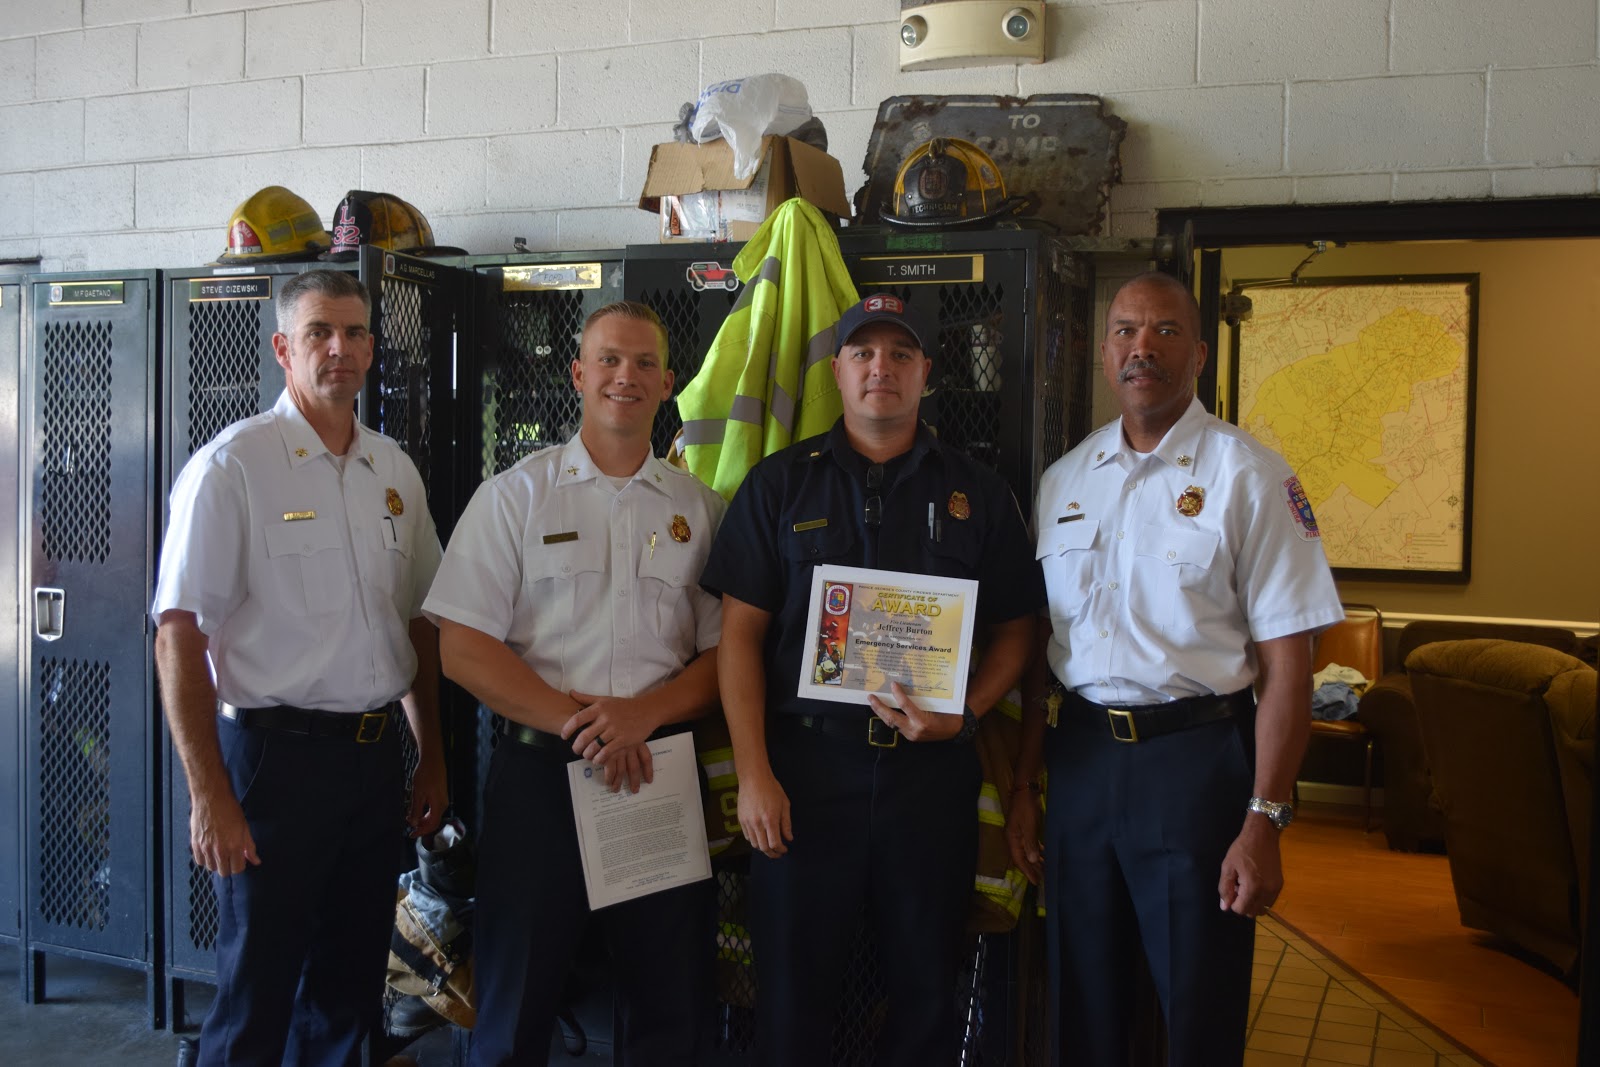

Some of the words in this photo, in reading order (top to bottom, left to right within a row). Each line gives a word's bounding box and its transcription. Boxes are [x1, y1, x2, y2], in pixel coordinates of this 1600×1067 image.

[1008, 114, 1040, 129] TO
[340, 205, 355, 224] L
[333, 225, 360, 245] 32
[887, 265, 897, 276] T.
[900, 264, 936, 276] SMITH
[201, 286, 223, 294] STEVE
[225, 285, 258, 293] CIZEWSKI
[869, 298, 898, 311] 32
[878, 592, 926, 603] CERTIFICATE
[871, 598, 942, 617] AWARD
[877, 623, 904, 633] Jeffrey
[906, 626, 933, 636] Burton
[855, 638, 895, 650] Emergency
[896, 642, 927, 652] Services
[928, 645, 952, 654] Award
